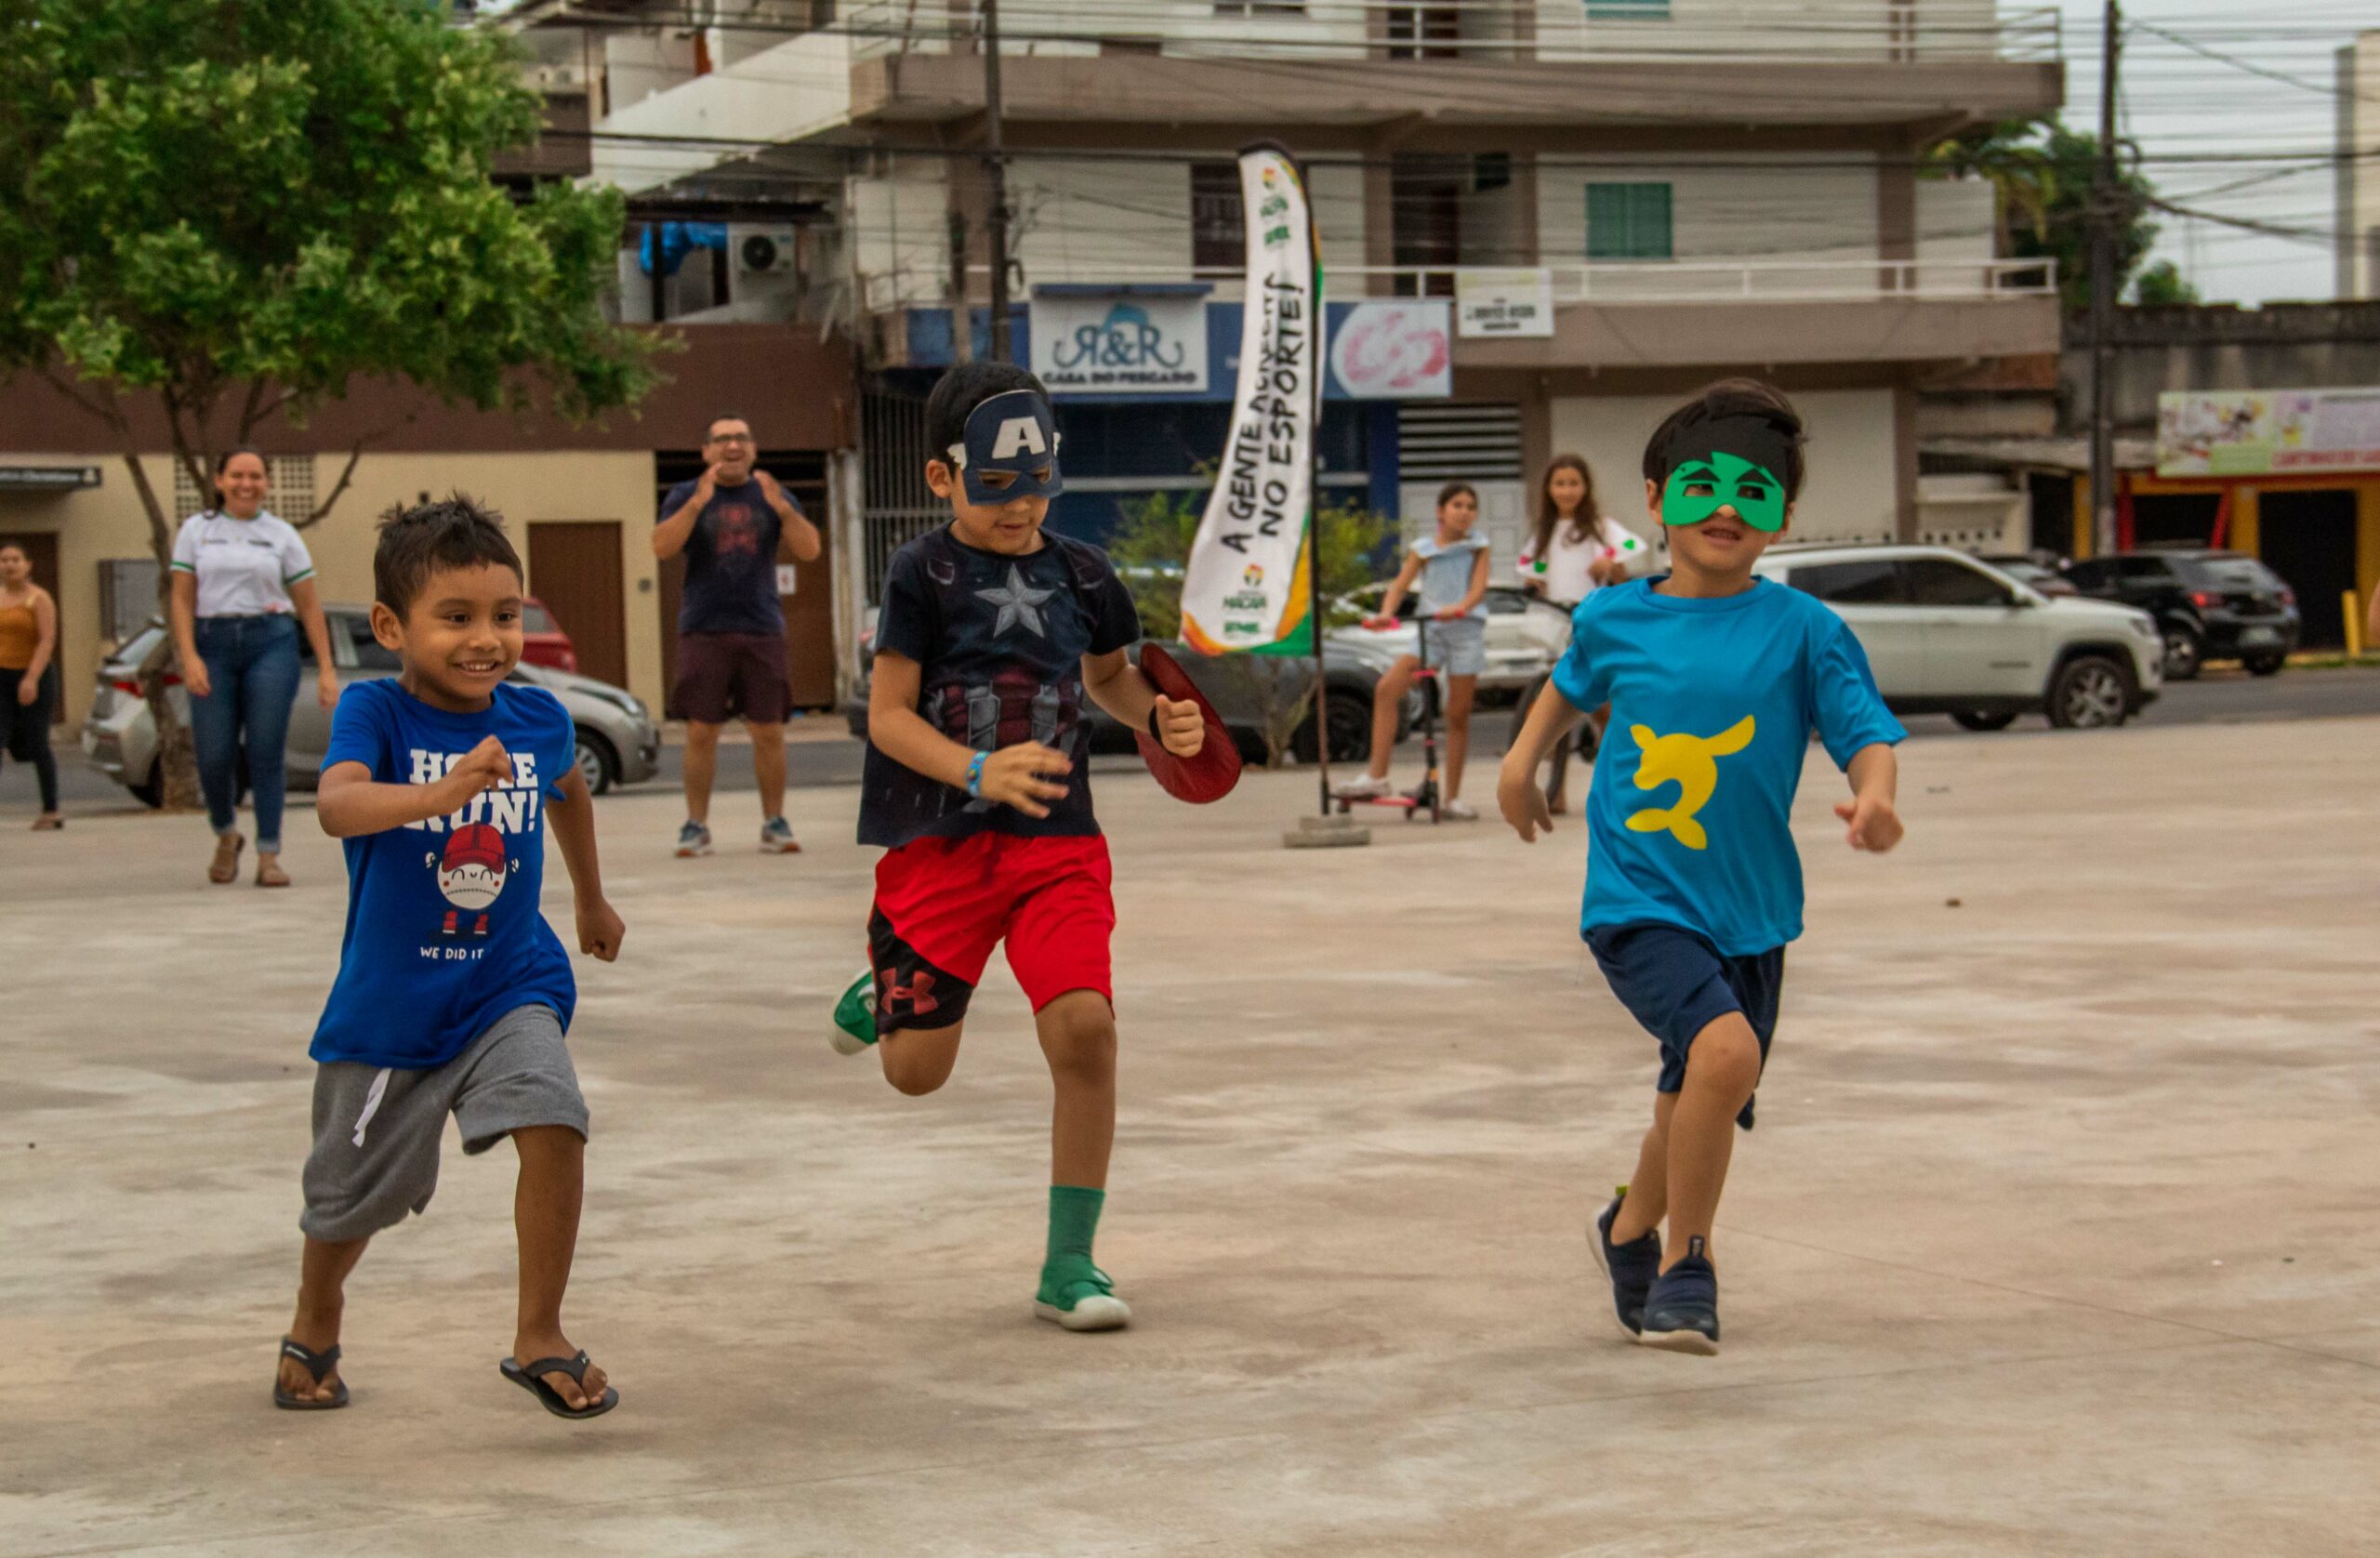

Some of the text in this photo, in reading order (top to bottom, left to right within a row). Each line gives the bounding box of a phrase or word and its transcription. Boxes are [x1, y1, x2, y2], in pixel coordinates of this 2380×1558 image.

[1042, 372, 1087, 384] CASA
[1092, 372, 1115, 384] DO
[1268, 283, 1303, 465] ESPORTE!
[992, 416, 1046, 459] A
[1227, 422, 1262, 521] GENTE
[1259, 480, 1289, 537] NO
[1221, 533, 1253, 554] A
[410, 749, 538, 789] HE
[420, 946, 483, 960] WE DID IT
